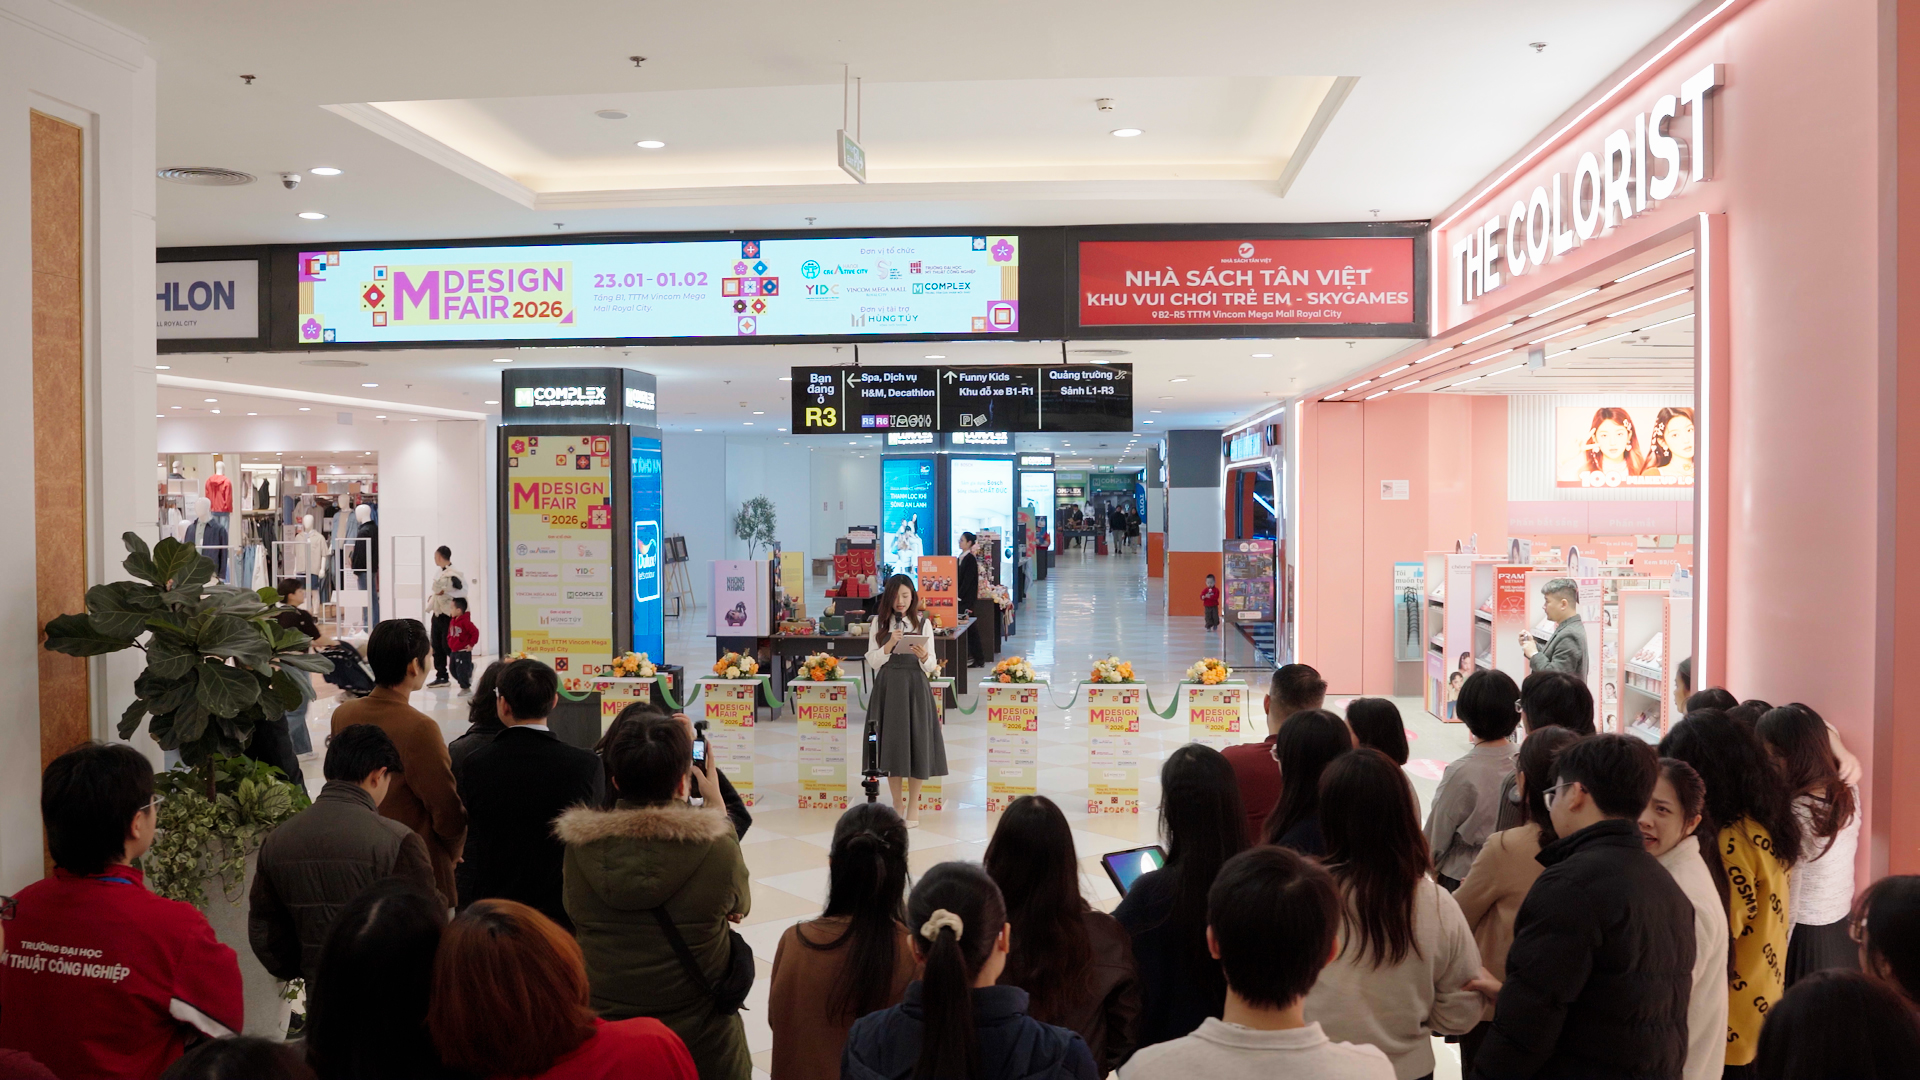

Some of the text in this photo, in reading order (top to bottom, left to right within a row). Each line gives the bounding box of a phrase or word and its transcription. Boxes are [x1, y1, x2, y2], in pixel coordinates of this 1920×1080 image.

[1453, 63, 1722, 306] THE COLORIST
[1126, 265, 1371, 289] NHÀ SÁCH TÂN VIỆT
[806, 284, 839, 295] YIDC
[924, 282, 971, 290] COMPLEX
[394, 268, 563, 320] M DESIGN
[683, 293, 706, 301] Mega
[1087, 288, 1408, 306] KHU VUI CHƠI TRẺ EM SKYGAMES
[444, 296, 563, 320] FAIR 2026
[612, 304, 634, 313] Royal
[868, 314, 896, 322] HÙNG
[1248, 310, 1274, 319] Mega
[1296, 310, 1321, 319] Royal
[1323, 310, 1342, 319] City
[810, 373, 832, 384] Bạn
[861, 372, 917, 383] Spa, Dịch vụ
[960, 373, 1010, 382] Funny Kids
[1050, 371, 1113, 381] Quảng trường
[534, 387, 606, 400] COMPLEX
[807, 384, 835, 395] đang
[861, 389, 935, 398] H&M, Decathlon
[960, 387, 980, 396] Khu
[981, 385, 992, 396] đỗ
[1006, 387, 1034, 396] B1-R1
[1060, 386, 1114, 395] Sảnh L1-R3
[817, 394, 825, 404] ở
[805, 407, 837, 427] R3
[1579, 471, 1676, 487] 100 MAKEUP
[514, 482, 604, 509] M DESIGN
[542, 497, 576, 509] FAIR
[552, 516, 578, 524] 2026
[603, 701, 616, 714] M
[706, 704, 719, 717] M
[799, 706, 812, 719] M
[989, 708, 1002, 721] M
[1091, 709, 1104, 722] M
[1191, 709, 1204, 722] M
[21, 940, 103, 960] TRƯỜNG ĐẠI HỌC
[10, 954, 47, 974] THUẬT
[48, 957, 81, 976] CÔNG
[82, 963, 130, 984] NGHIỆP
